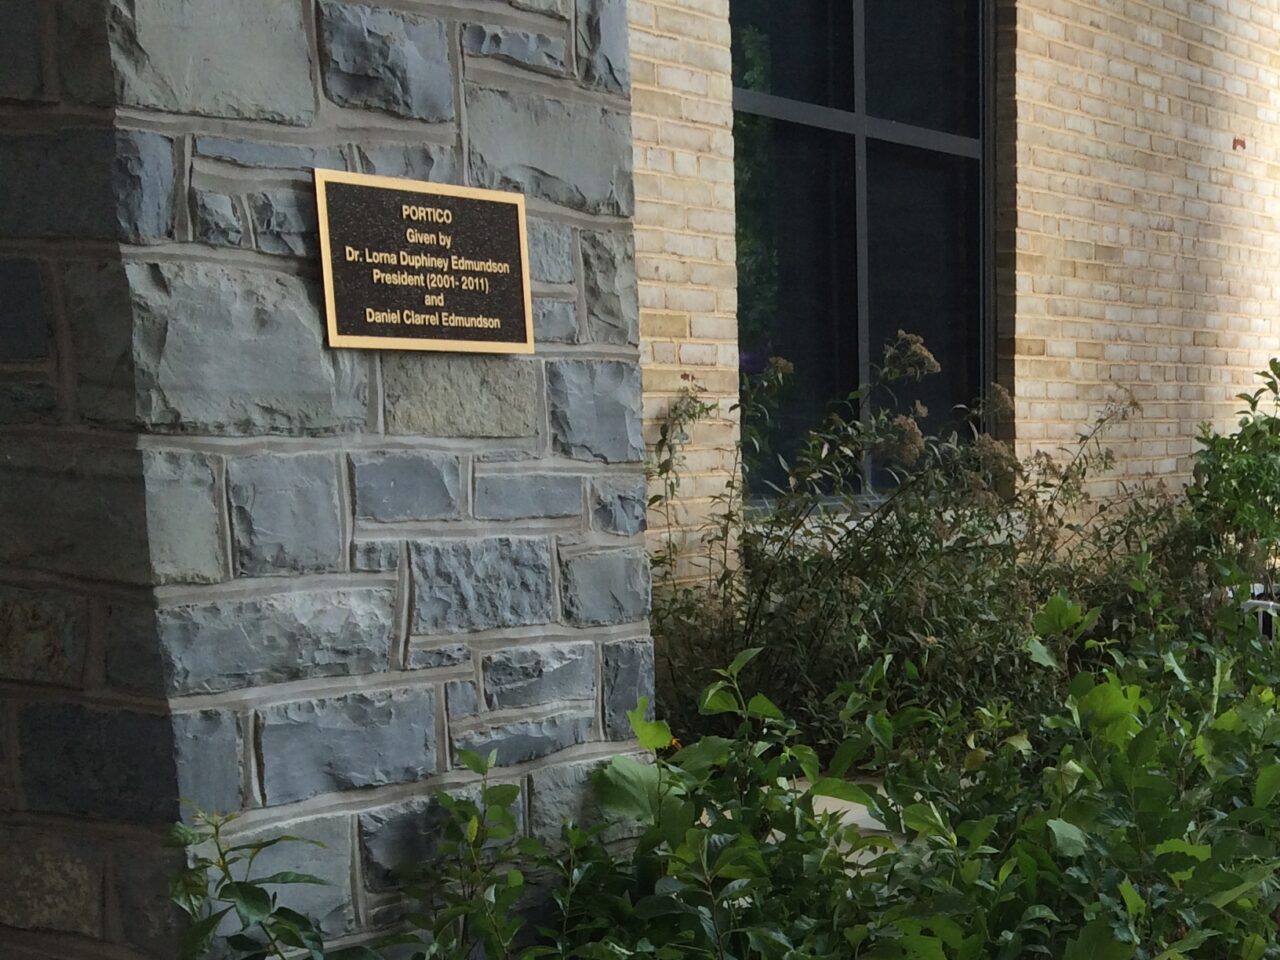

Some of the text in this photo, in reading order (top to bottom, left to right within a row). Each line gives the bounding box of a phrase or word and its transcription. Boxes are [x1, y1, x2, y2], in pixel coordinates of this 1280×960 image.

[403, 205, 452, 223] PORTICO
[407, 229, 451, 248] Given by
[346, 247, 509, 273] Dr. Lorna Duphiney Edmundson
[373, 270, 425, 286] President
[462, 277, 488, 294] 2011)
[425, 294, 444, 306] and
[366, 308, 500, 328] Daniel Clarrel Edmundson
